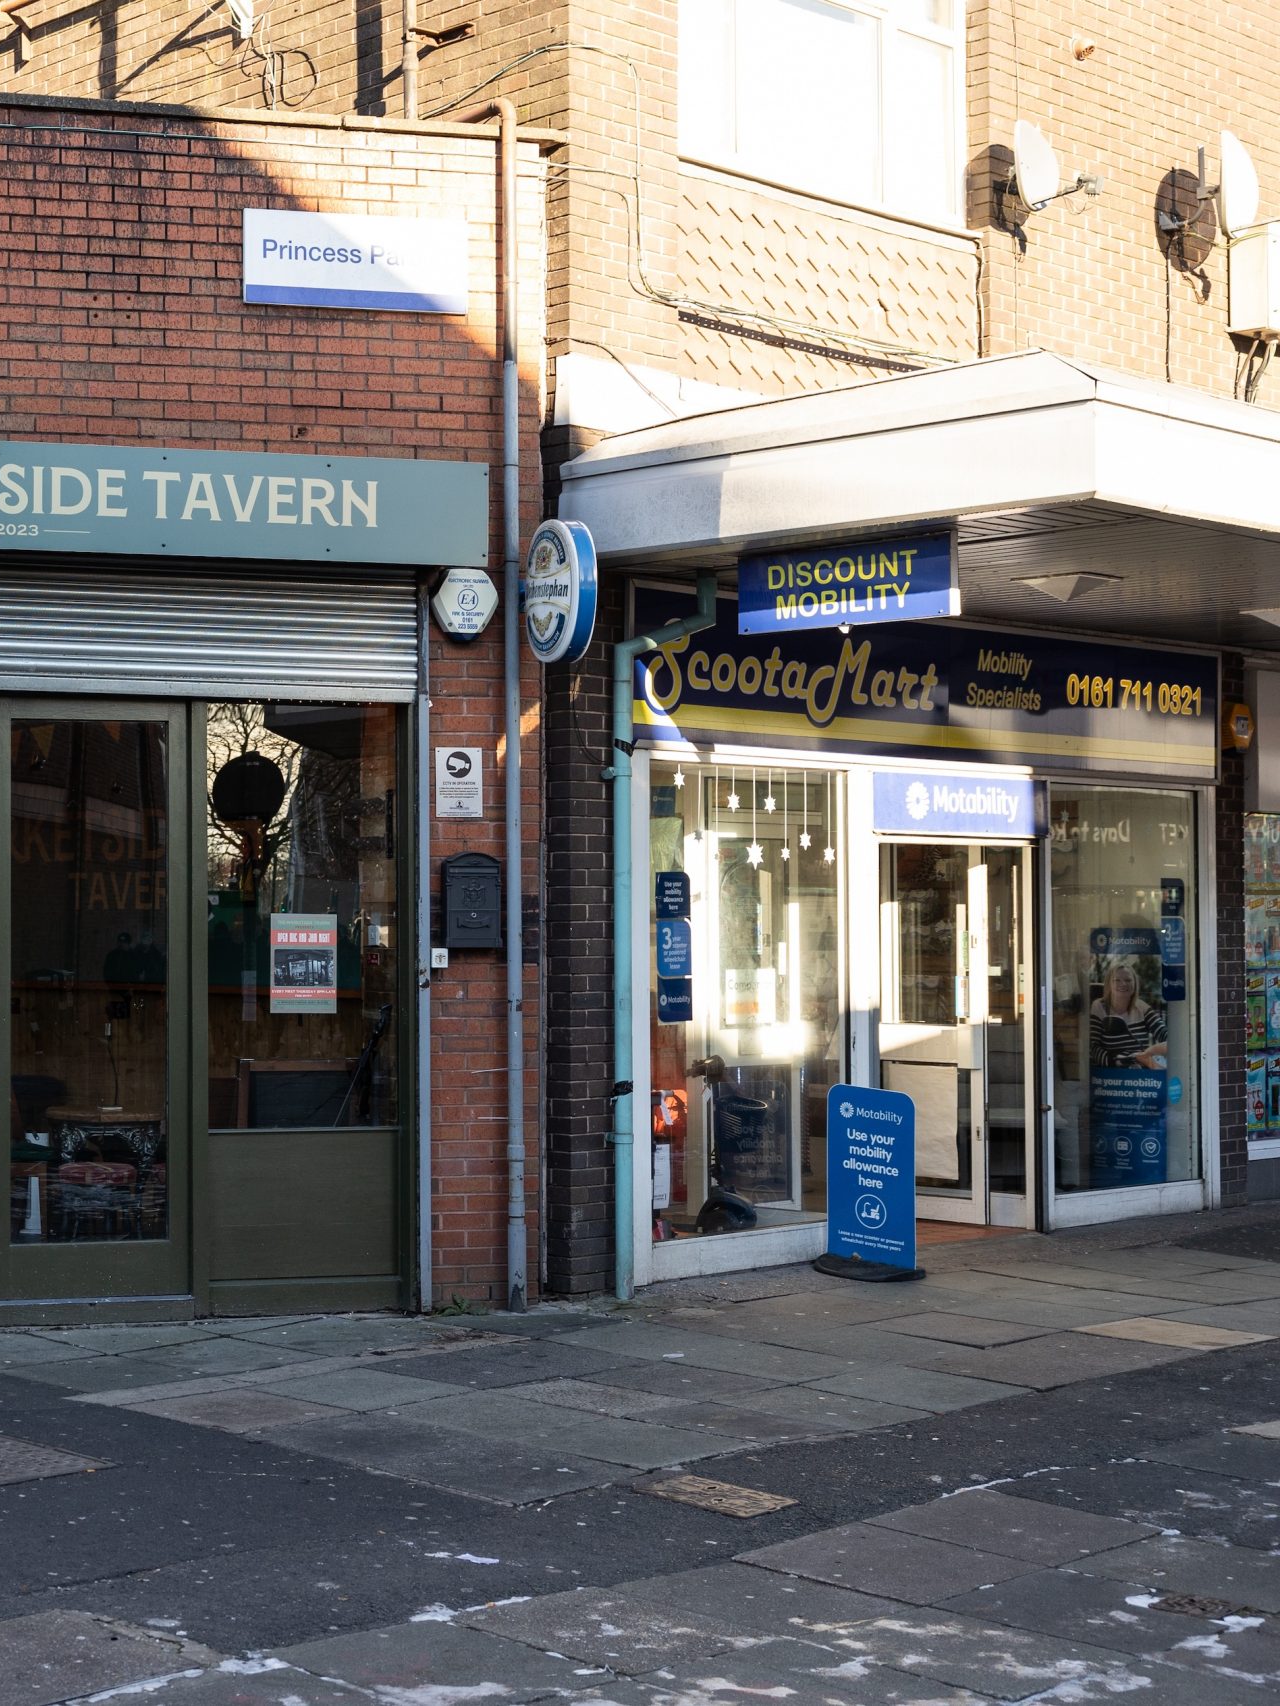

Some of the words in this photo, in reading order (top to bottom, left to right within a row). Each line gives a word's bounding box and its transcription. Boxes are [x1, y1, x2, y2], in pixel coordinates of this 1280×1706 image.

[262, 238, 362, 264] Princess
[142, 470, 378, 528] TAVERN
[767, 549, 917, 590] DISCOUNT
[775, 581, 911, 620] MOBILITY
[977, 648, 1032, 681] Mobility
[966, 682, 1041, 711] Specialists
[1066, 673, 1114, 708] 0161
[1120, 679, 1153, 711] 711
[1158, 682, 1202, 717] 0321
[933, 785, 1019, 823] Motability
[665, 888, 681, 896] mobility
[673, 881, 682, 889] your
[662, 927, 672, 950] 3
[1108, 936, 1152, 947] Motability
[669, 948, 686, 957] powered
[668, 996, 690, 1005] Motability
[1103, 1078, 1122, 1087] your
[1124, 1078, 1162, 1089] mobility
[1136, 1090, 1158, 1098] here
[856, 1107, 903, 1125] Motability
[847, 1127, 867, 1141] Use
[870, 1133, 895, 1146] your
[849, 1145, 892, 1163] mobility
[843, 1158, 899, 1177] allowance
[858, 1174, 883, 1189] here
